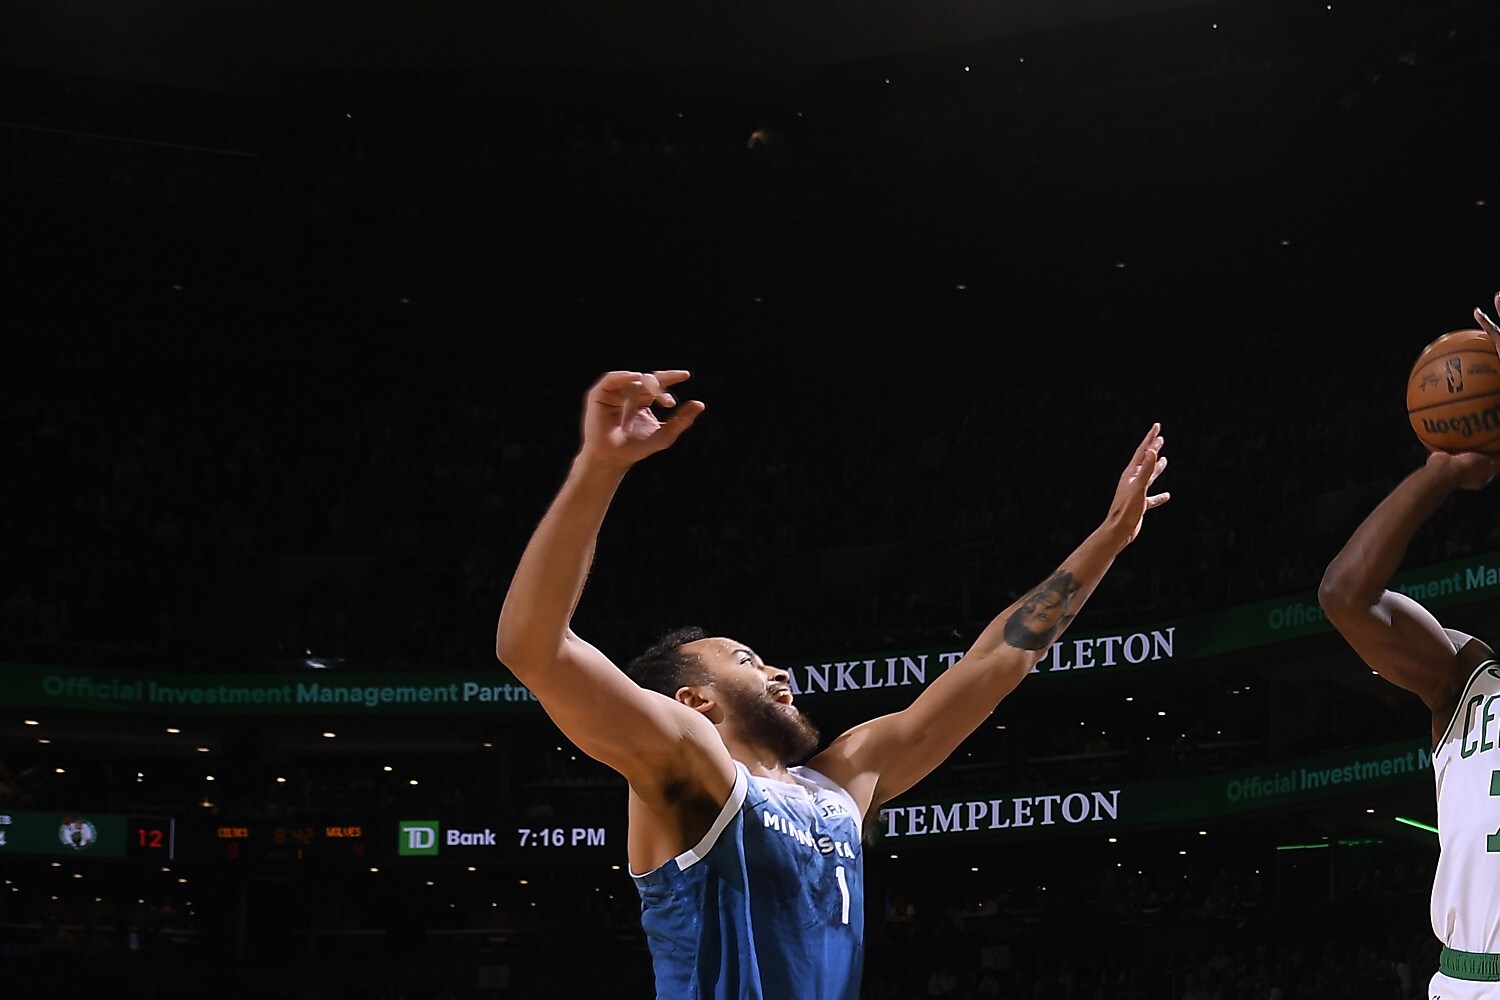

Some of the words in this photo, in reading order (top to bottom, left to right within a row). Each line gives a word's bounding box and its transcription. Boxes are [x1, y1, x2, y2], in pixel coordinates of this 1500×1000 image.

[43, 675, 143, 700] Official
[149, 681, 291, 704] Investment
[297, 682, 459, 707] Management
[1227, 770, 1296, 802] Official
[1301, 752, 1414, 790] Investment
[881, 790, 1121, 837] TEMPLETON
[137, 829, 164, 848] 12
[402, 826, 436, 849] TD
[446, 828, 497, 846] Bank
[517, 827, 566, 847] 7:16
[571, 827, 607, 847] PM
[835, 865, 850, 925] 1
